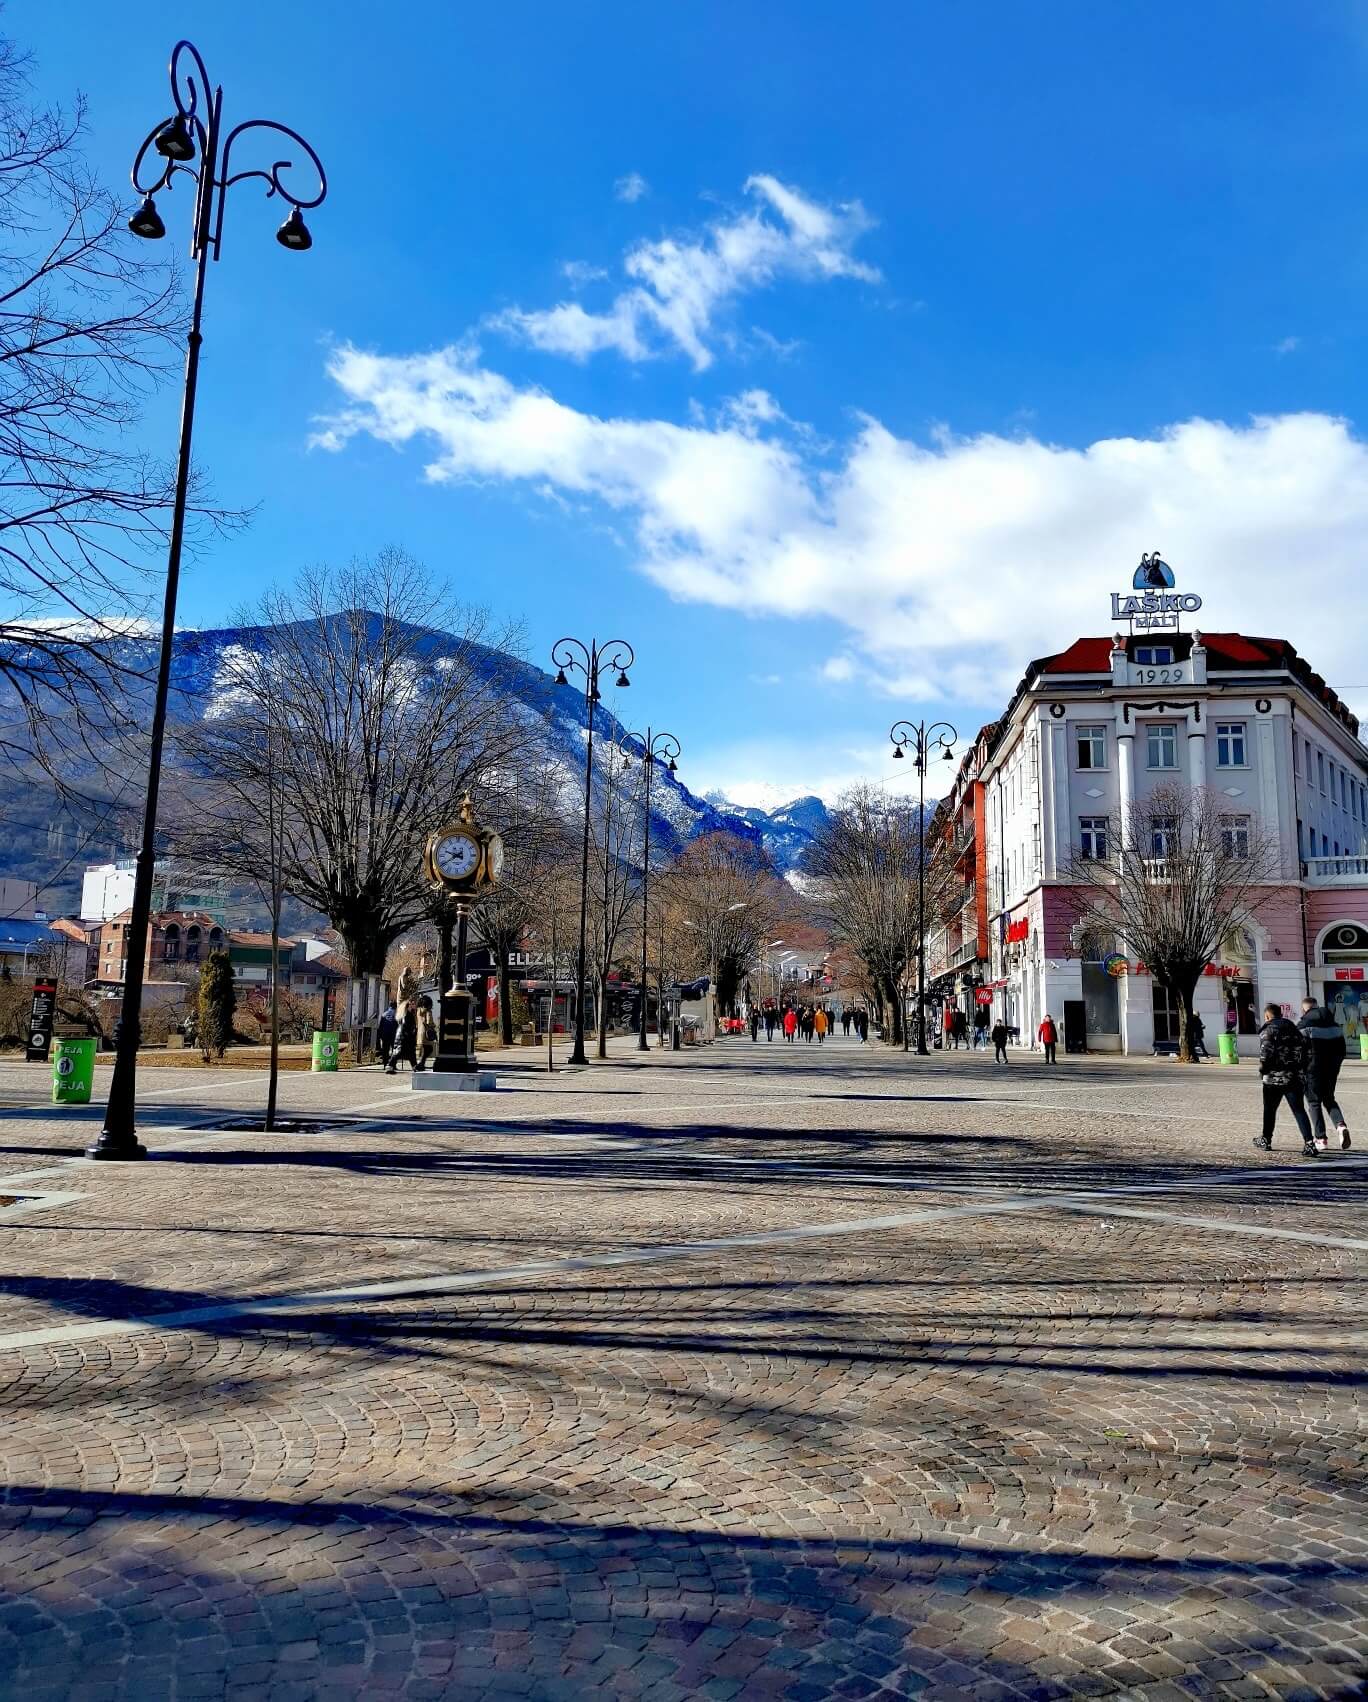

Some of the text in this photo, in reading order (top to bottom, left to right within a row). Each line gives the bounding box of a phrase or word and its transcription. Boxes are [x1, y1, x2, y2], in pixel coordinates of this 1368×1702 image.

[1110, 592, 1202, 620] LAŠKO
[1136, 669, 1183, 684] 1929
[978, 990, 992, 1001] illy
[58, 1046, 83, 1054] PEJA
[53, 1079, 85, 1091] PEJA
